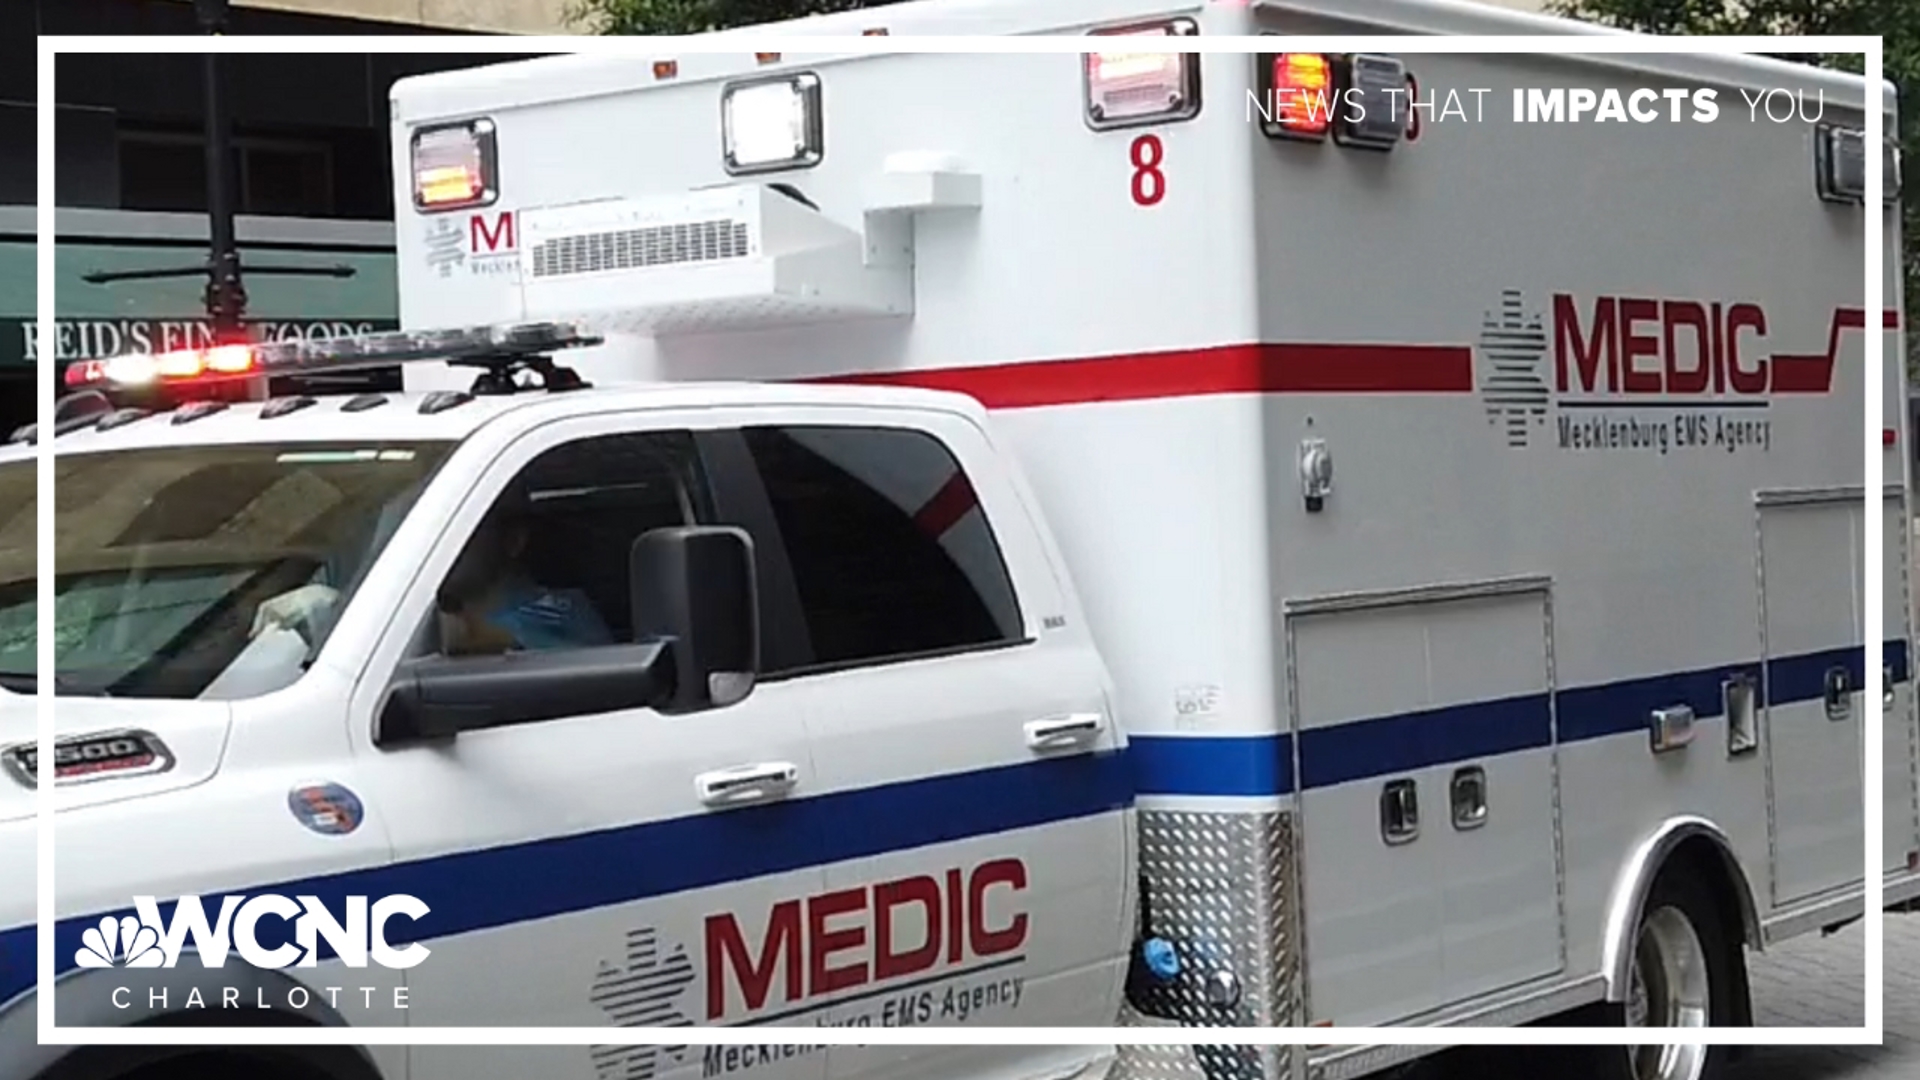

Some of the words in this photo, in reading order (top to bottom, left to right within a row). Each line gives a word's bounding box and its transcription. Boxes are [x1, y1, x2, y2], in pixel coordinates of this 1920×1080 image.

[1130, 133, 1166, 206] 8
[160, 321, 217, 354] FIN
[1553, 293, 1768, 395] MEDIC
[1557, 414, 1667, 455] Mecklenburg
[1675, 414, 1709, 447] EMS
[1715, 415, 1771, 454] Agency
[704, 858, 1028, 1020] MEDIC
[882, 991, 932, 1028] EMS
[940, 977, 1025, 1022] Agency
